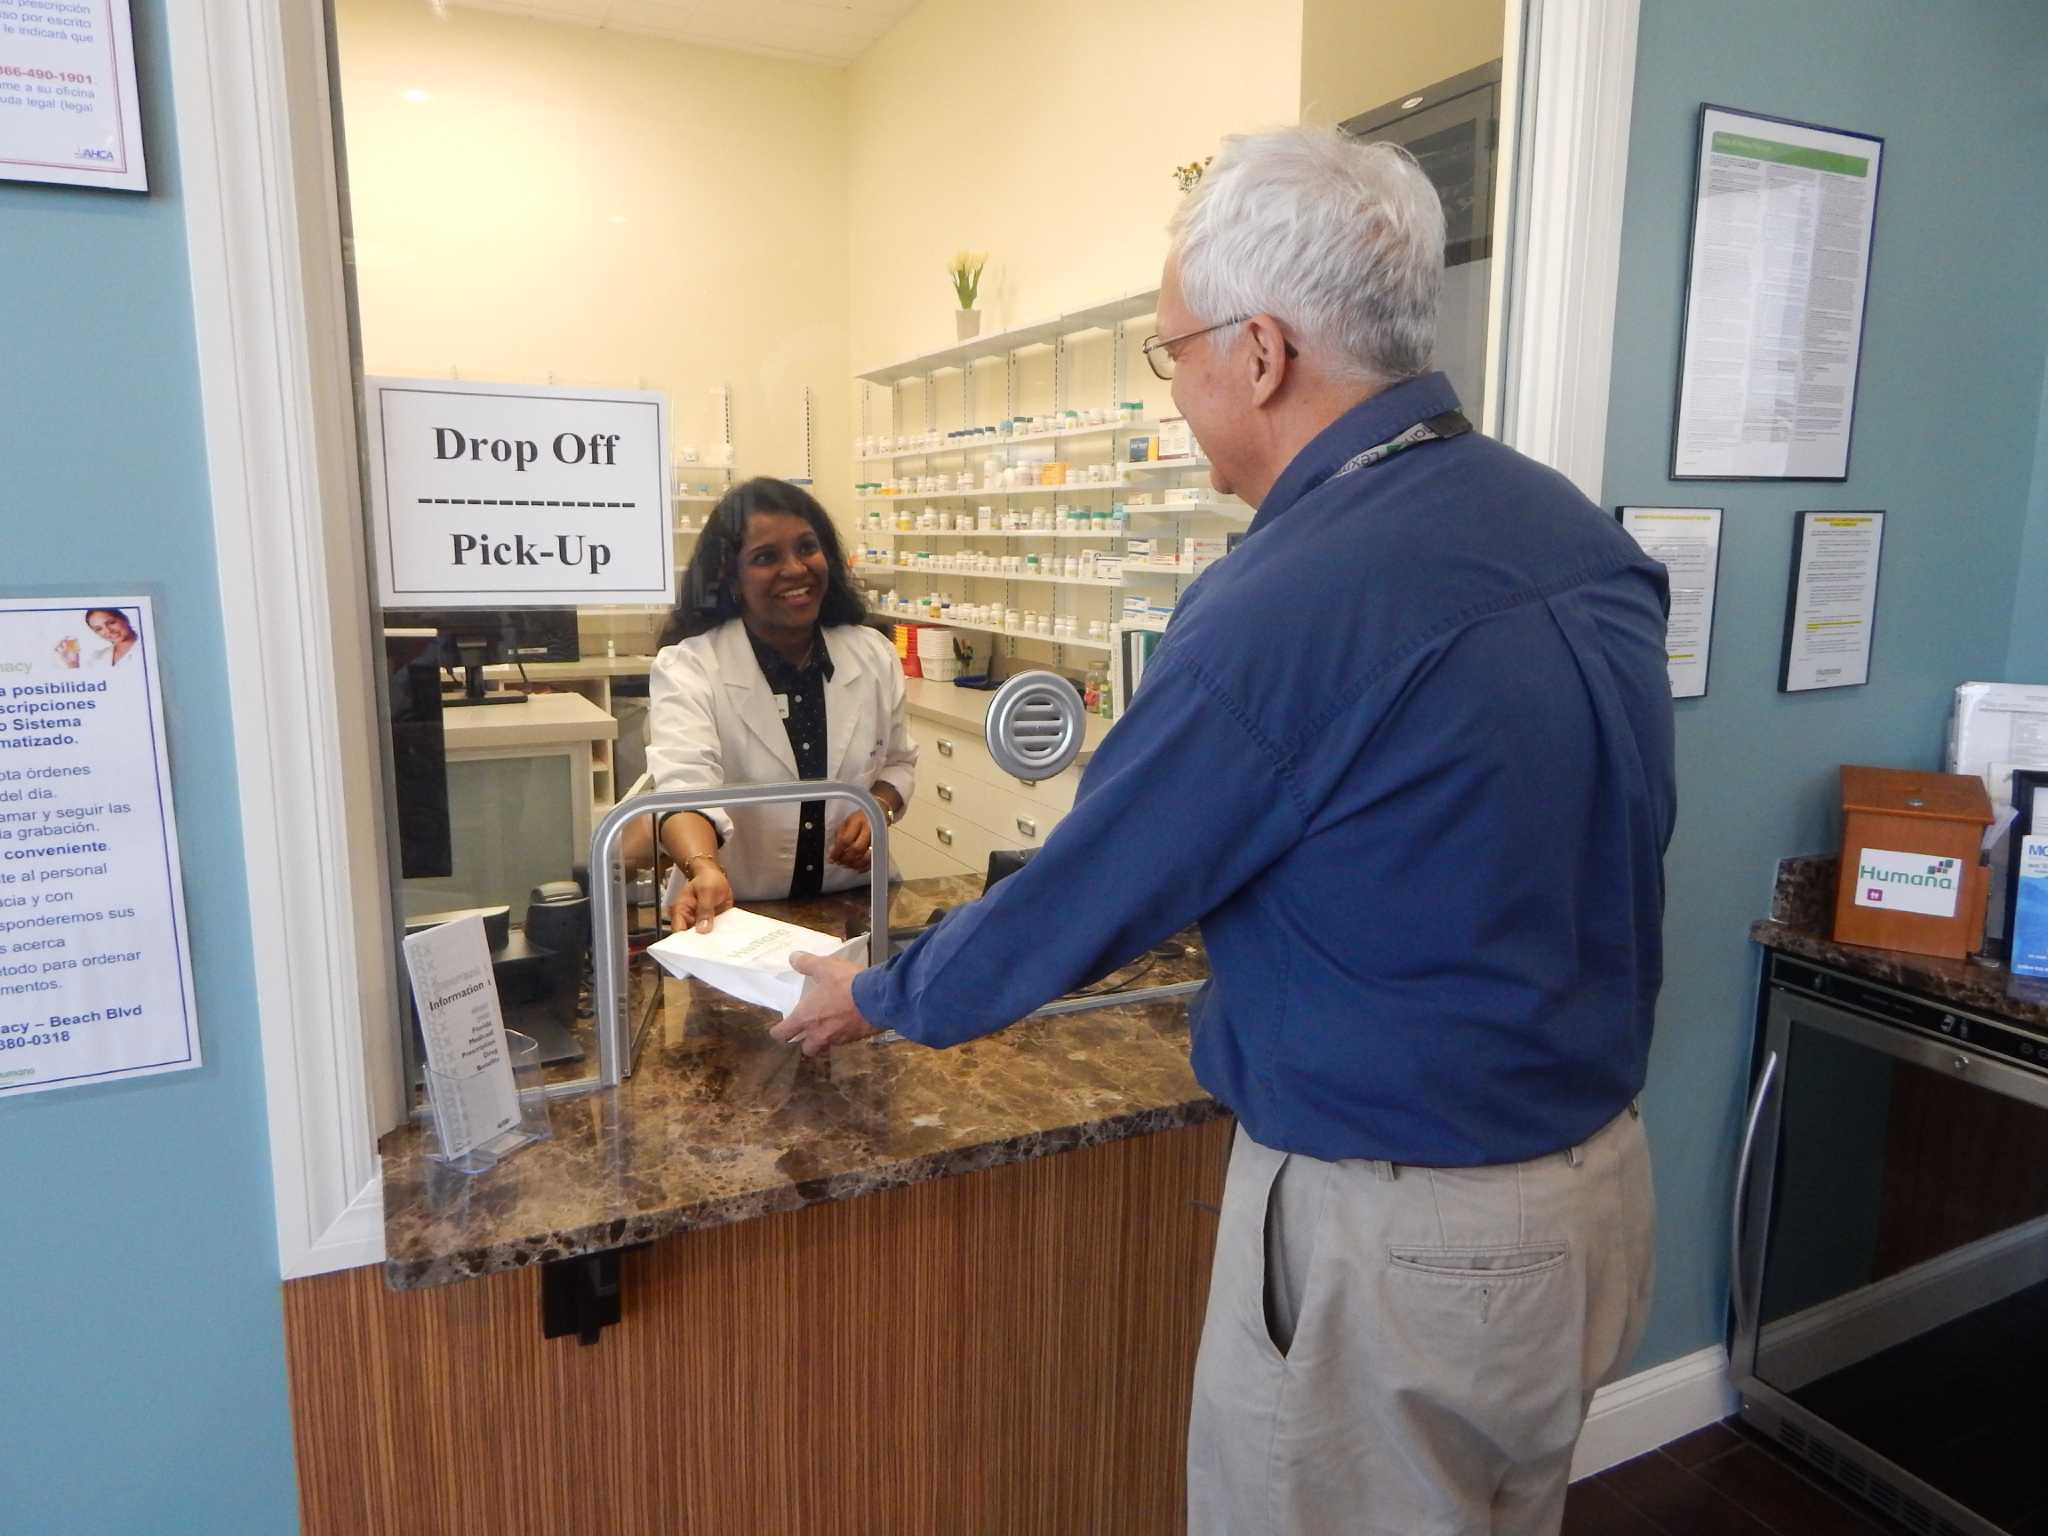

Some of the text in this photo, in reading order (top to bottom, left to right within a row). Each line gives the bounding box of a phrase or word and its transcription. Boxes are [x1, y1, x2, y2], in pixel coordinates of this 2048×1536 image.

[22, 13, 43, 23] por
[47, 15, 92, 28] escrito
[4, 23, 15, 33] le
[71, 32, 94, 44] que
[24, 84, 33, 93] a
[56, 86, 96, 99] oficina
[27, 97, 56, 110] legal
[431, 426, 620, 472] Drop Off
[450, 533, 612, 574] Pick-Up
[13, 680, 107, 699] posibilidad
[13, 718, 82, 731] Sistema
[42, 810, 52, 822] y
[56, 804, 104, 820] seguir
[109, 802, 132, 814] las
[17, 821, 100, 841] grabación.
[4, 842, 111, 860] conveniente.
[21, 869, 35, 882] al
[40, 863, 108, 883] personal
[1860, 864, 1953, 890] Humana
[31, 895, 40, 908] y
[45, 891, 73, 903] con
[108, 907, 136, 919] sus
[12, 938, 66, 953] acerca
[42, 958, 78, 974] para
[82, 951, 141, 967] ordenar
[429, 981, 485, 1012] Information
[49, 1010, 101, 1028] Beach
[106, 1004, 143, 1020] Blvd
